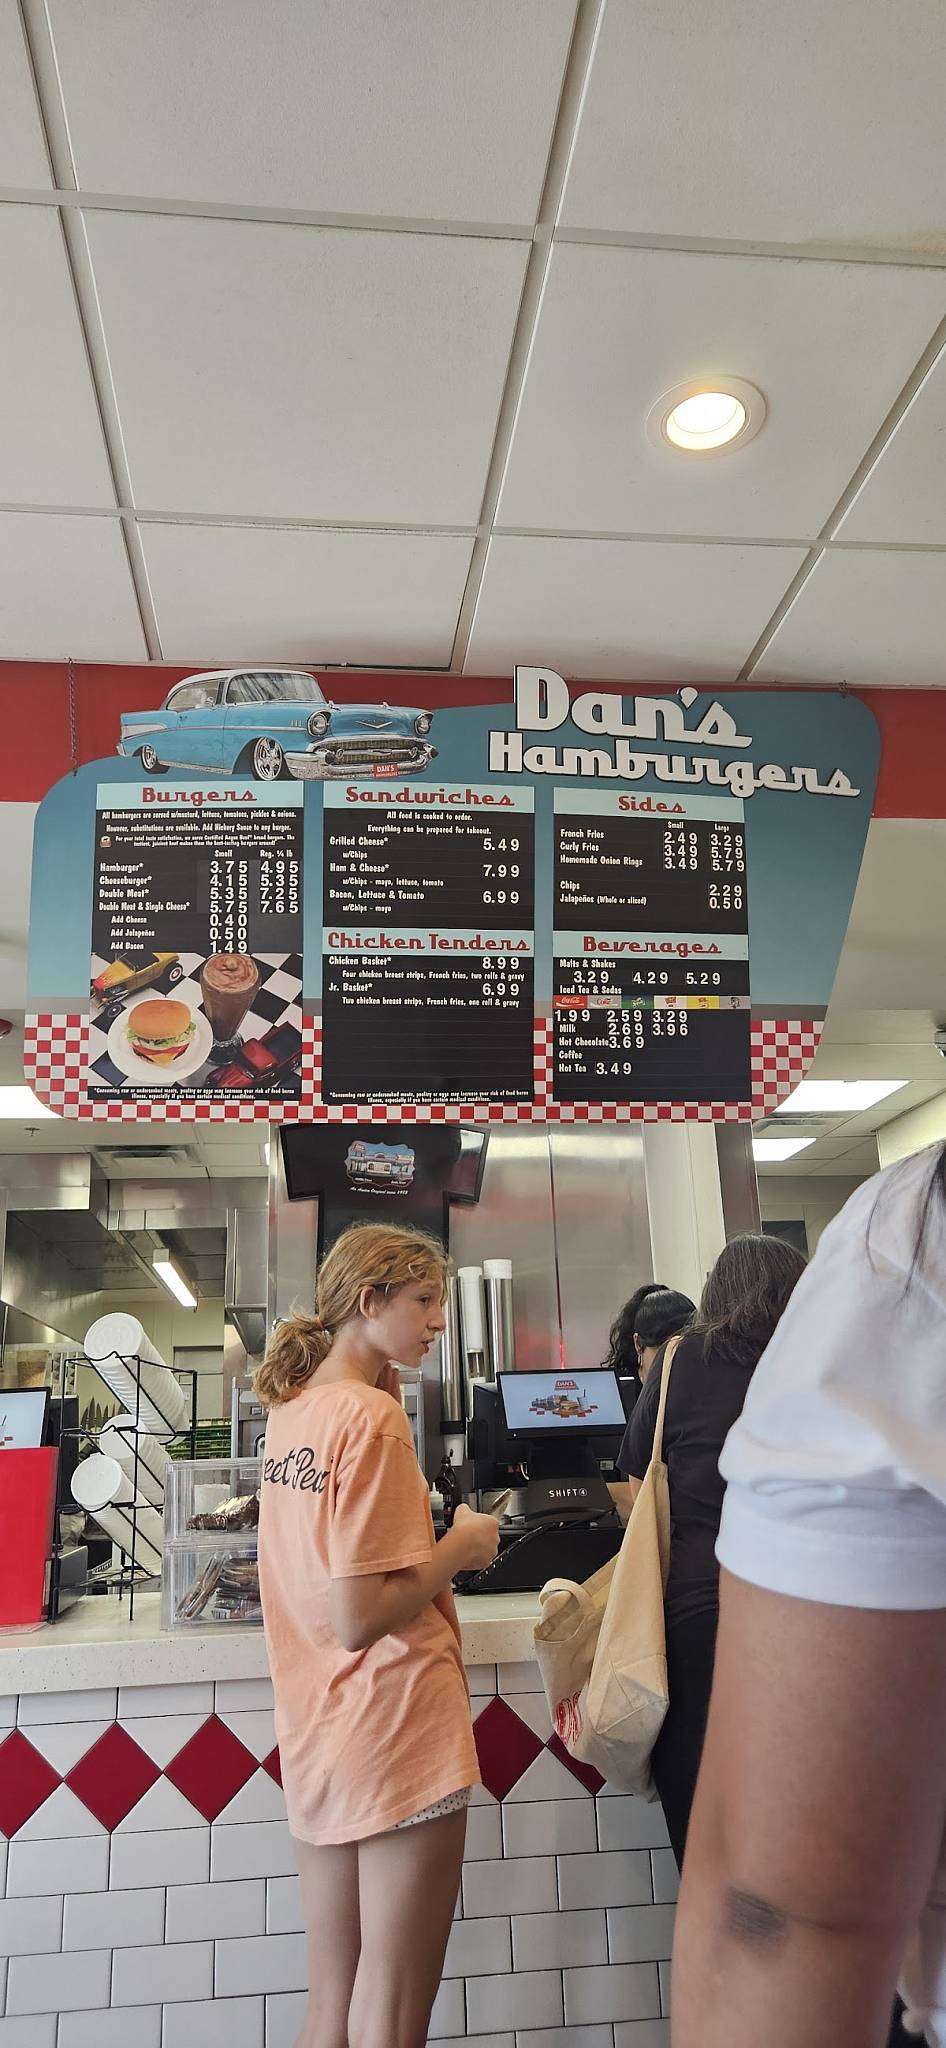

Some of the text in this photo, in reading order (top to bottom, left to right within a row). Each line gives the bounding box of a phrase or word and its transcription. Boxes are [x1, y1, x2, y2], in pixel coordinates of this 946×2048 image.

[514, 665, 752, 748] Dan's
[489, 731, 860, 798] Hamburgers
[142, 787, 257, 806] Burgers
[346, 786, 514, 806] Sandwiches
[618, 795, 687, 813] Sides
[102, 811, 110, 819] All
[271, 810, 276, 818] &
[387, 811, 472, 821] All food is cooked to order.
[367, 824, 401, 834] Everything
[416, 825, 423, 833] be
[426, 825, 453, 835] prepared
[455, 826, 464, 834] for
[667, 821, 729, 832] Small Large
[329, 836, 355, 846] Grilled
[483, 838, 519, 851] 5.49
[560, 828, 743, 847] French Fries 2.49 3.29
[214, 849, 232, 857] Small
[260, 849, 274, 859] Reg.
[343, 850, 368, 860] w/Chips
[560, 841, 743, 859] Curly Fries 3.49 5.79
[210, 860, 248, 873] 3.75
[261, 860, 298, 873] 4.95
[560, 854, 745, 872] Homemade Onion Rings 3.49 5.79
[329, 863, 346, 872] Ham
[350, 863, 356, 872] &
[483, 864, 520, 877] 7.99
[210, 874, 247, 886] 4.15
[261, 874, 298, 886] 5.35
[343, 877, 367, 887] w/Chips
[423, 879, 444, 887] tomato
[99, 888, 124, 898] Double
[210, 887, 247, 900] 5.35
[260, 887, 298, 900] 7.25
[560, 880, 742, 897] Chips 2.29
[329, 889, 519, 904] Bacon, Lettuce & Tomato 6.99
[560, 893, 594, 904] Jalapeños
[597, 895, 617, 904] (Whole
[627, 896, 647, 905] sliced)
[709, 896, 742, 910] 0.50
[99, 901, 119, 911] Double
[121, 902, 136, 911] Meat
[138, 901, 143, 911] &
[145, 901, 164, 913] Single
[210, 900, 248, 913] 5.75
[261, 900, 298, 913] 7.65
[343, 903, 391, 914] w/Chips mayo
[111, 914, 247, 926] Add Cheese 0.40
[111, 928, 123, 937] Add
[210, 927, 247, 940] 0.50
[111, 940, 247, 953] Add Bacon 1.49
[328, 932, 530, 951] Chicken Tenders
[583, 936, 722, 957] Beverages
[328, 955, 358, 965] Chicken
[482, 957, 519, 969] 8.99
[559, 959, 616, 968] Malts & Shakes
[342, 970, 356, 978] Four
[359, 970, 382, 978] chicken
[384, 970, 404, 979] breast
[406, 971, 426, 980] strips,
[428, 971, 450, 979] French
[452, 971, 468, 980] fries,
[484, 972, 498, 980] rolls
[500, 972, 506, 980] &
[508, 973, 525, 981] gravy
[573, 970, 721, 985] 3.29 4.29 5.29
[328, 982, 339, 992] Jr.
[482, 983, 519, 996] 6.99
[560, 985, 622, 994] Iced Tea & Sodas
[342, 996, 354, 1005] Two
[356, 996, 380, 1005] chicken
[382, 997, 402, 1005] breast
[404, 997, 424, 1007] strips,
[427, 997, 447, 1005] French
[450, 997, 466, 1006] fries,
[482, 998, 492, 1006] roll
[495, 998, 500, 1006] &
[503, 1000, 520, 1008] gravy
[555, 1009, 687, 1023] 1.99 2.59 3.29
[559, 1023, 688, 1036] Milk 2.69 3.96
[559, 1036, 645, 1049] Hot Chocolate 3.69
[559, 1050, 582, 1059] Coffee
[559, 1062, 632, 1075] Hot Tea 3.49
